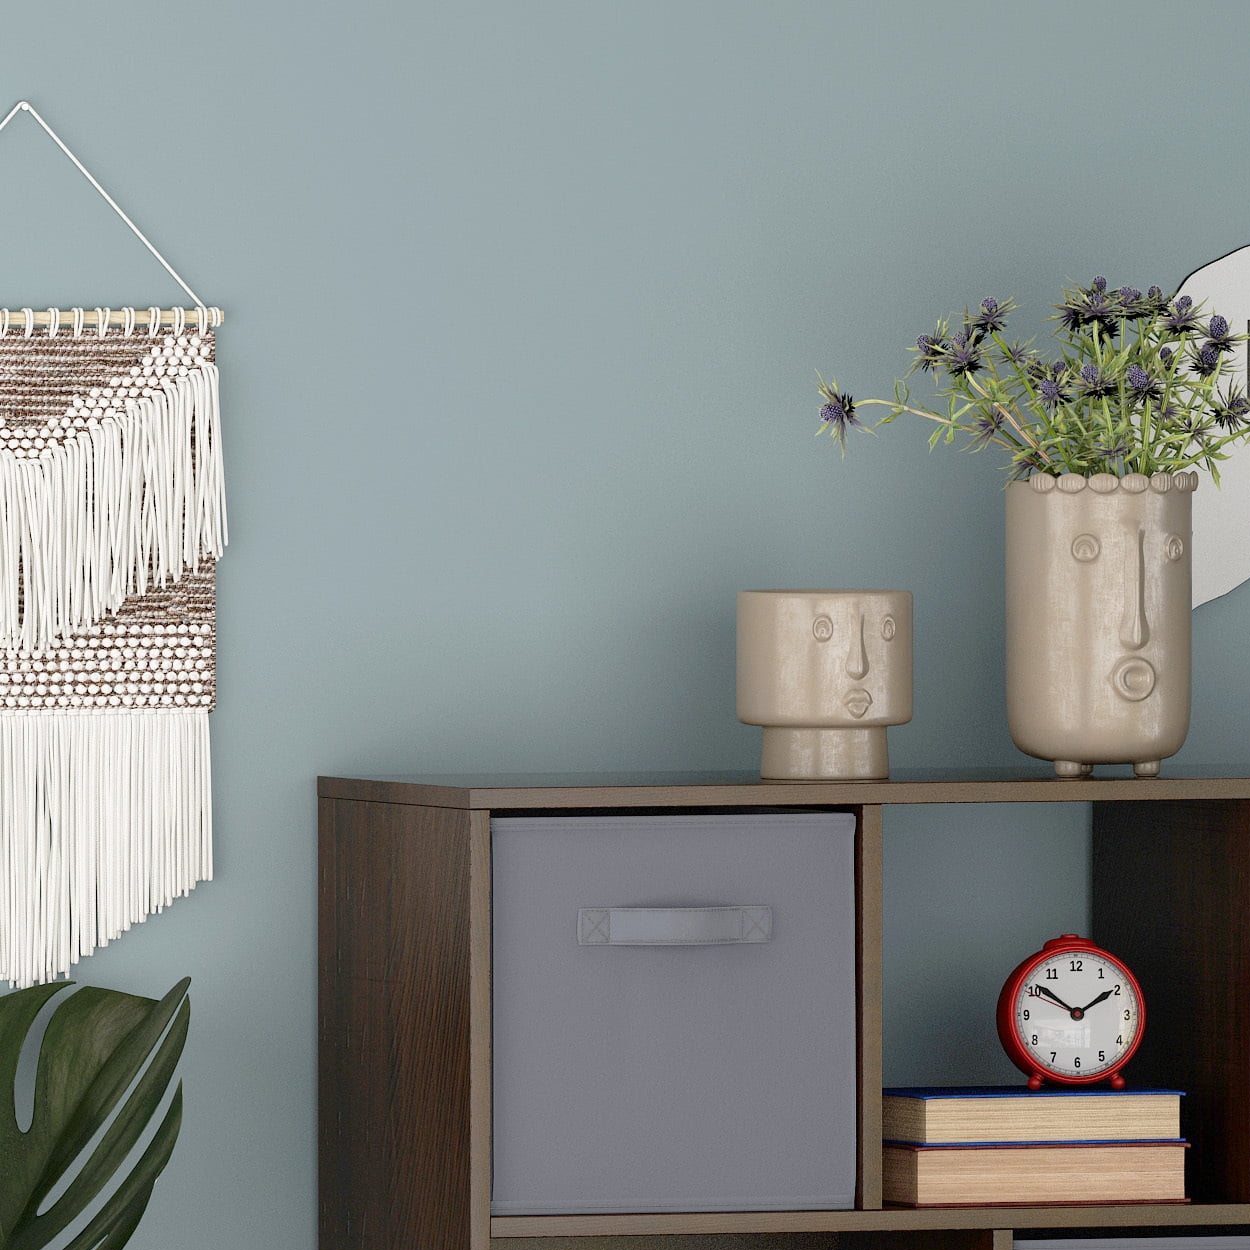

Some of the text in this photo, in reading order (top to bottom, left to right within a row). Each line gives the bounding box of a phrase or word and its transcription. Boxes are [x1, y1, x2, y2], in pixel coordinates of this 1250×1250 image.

[1070, 960, 1083, 972] 12
[1046, 968, 1058, 980] 11
[1098, 968, 1105, 979] 1
[1028, 986, 1041, 997] 10
[1114, 985, 1121, 996] 2
[1023, 1009, 1030, 1021] 9
[1123, 1009, 1130, 1021] 3
[1031, 1034, 1038, 1045] 8
[1116, 1034, 1122, 1046] 4
[1050, 1051, 1057, 1063] 7
[1099, 1050, 1105, 1062] 5
[1074, 1057, 1081, 1068] 6
